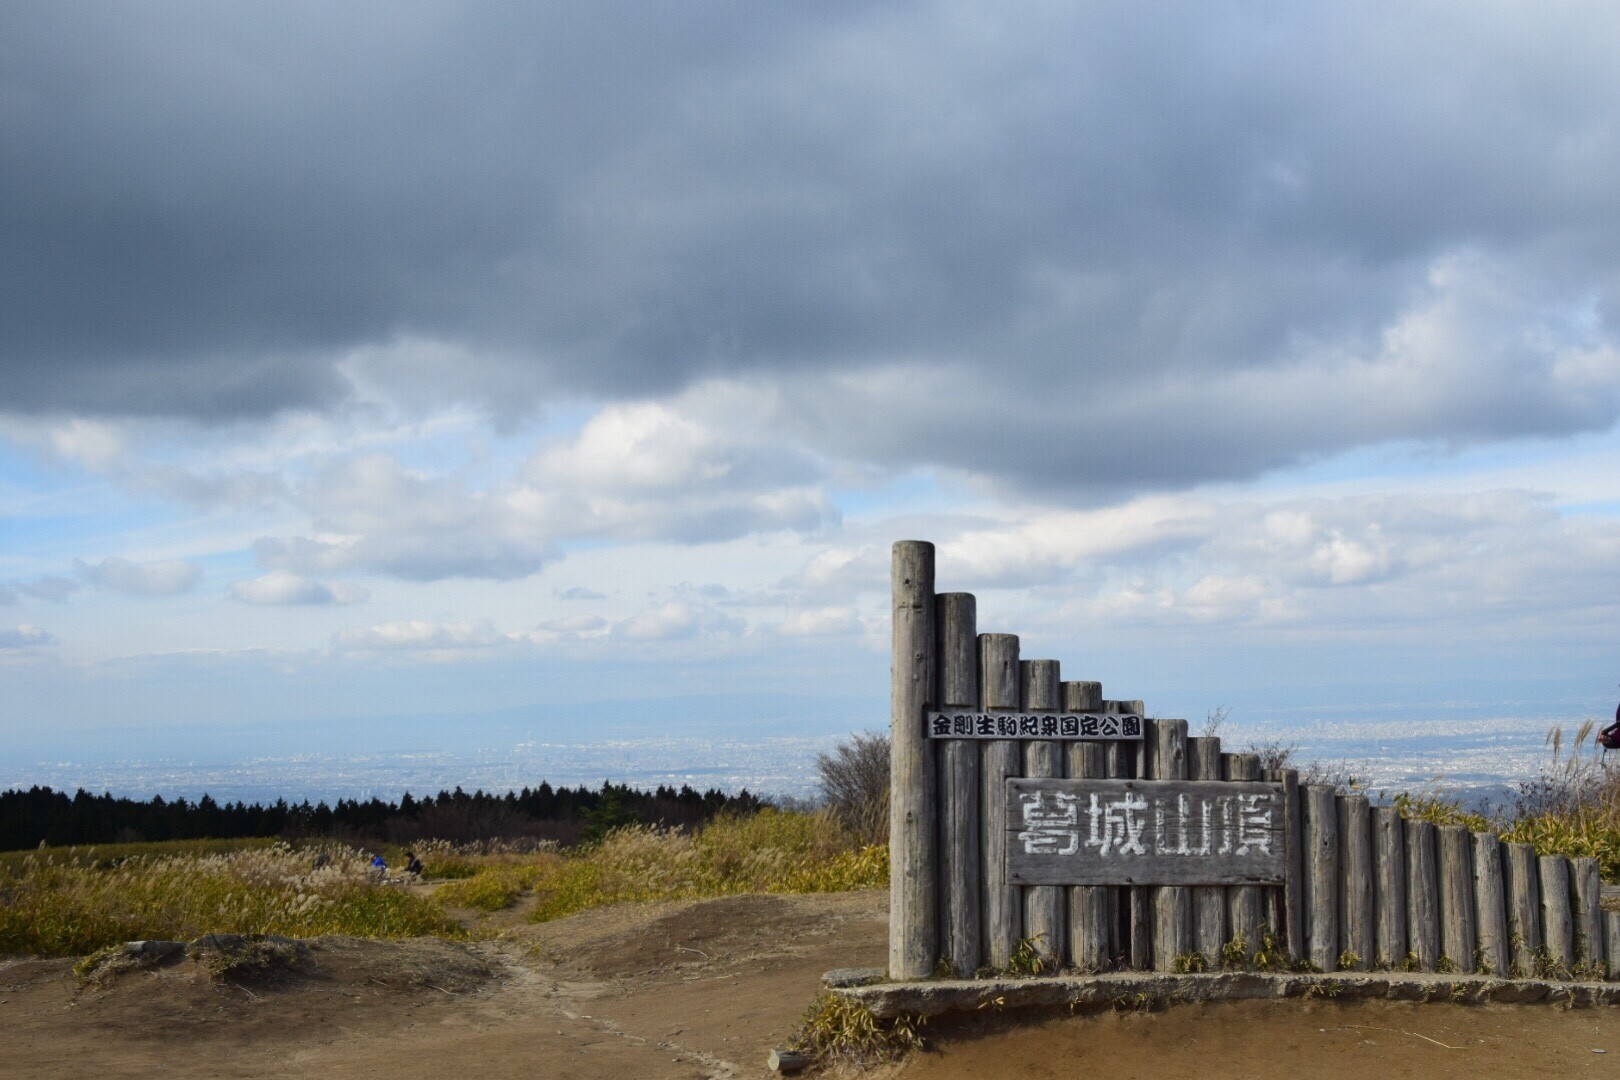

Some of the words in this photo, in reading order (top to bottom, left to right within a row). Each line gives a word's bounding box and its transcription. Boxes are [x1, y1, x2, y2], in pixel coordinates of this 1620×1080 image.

[932, 714, 1141, 737] 金剛生駒紀泉国定公園
[1018, 790, 1275, 856] 葛城山頂
